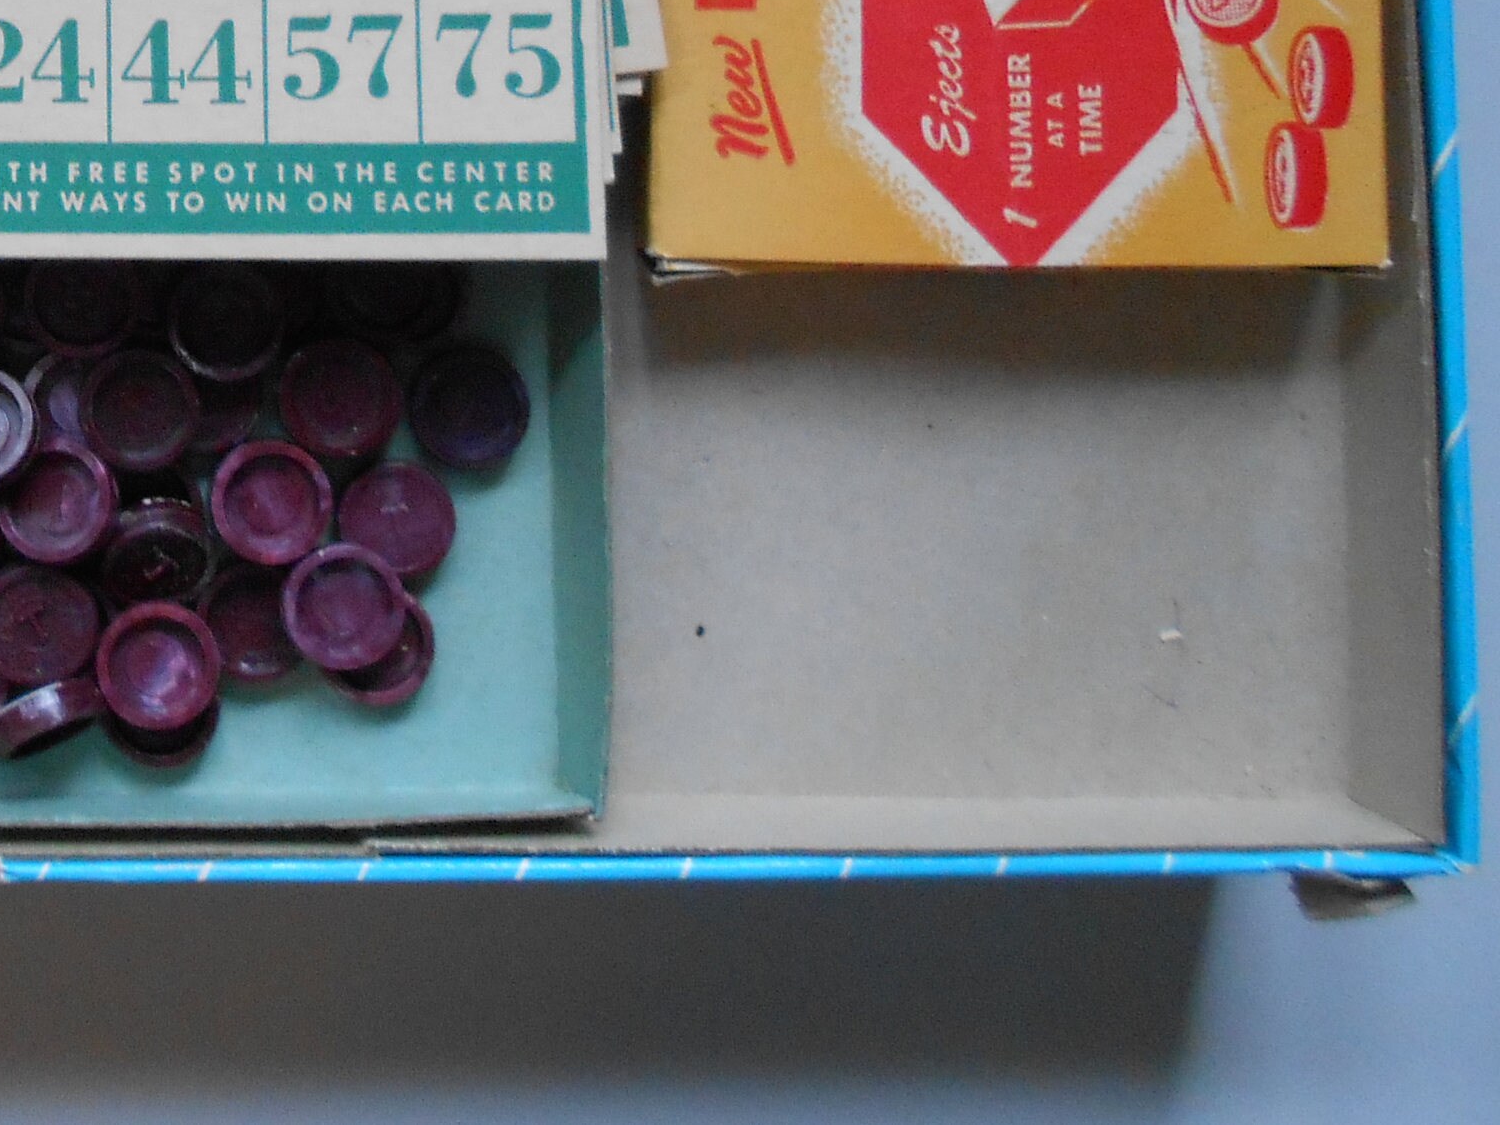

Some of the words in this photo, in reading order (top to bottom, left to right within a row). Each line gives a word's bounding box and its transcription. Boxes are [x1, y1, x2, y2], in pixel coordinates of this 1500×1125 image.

[122, 20, 251, 104] 44
[284, 15, 402, 100] 57
[437, 14, 561, 98] 75
[709, 34, 770, 159] New
[921, 24, 977, 156] Ejects
[1046, 91, 1065, 110] A
[1007, 51, 1032, 192] NUMBER
[1047, 118, 1063, 147] AT
[1077, 81, 1102, 156] TIME
[68, 161, 149, 184] FREE
[168, 161, 258, 185] SPOT
[277, 162, 315, 184] IN
[334, 161, 397, 184] THE
[416, 160, 553, 184] CENTER
[60, 190, 147, 214] WAYS
[166, 191, 205, 215] TO
[224, 191, 287, 213] WIN
[307, 191, 353, 214] ON
[373, 190, 454, 214] EACH
[474, 190, 556, 213] CARD
[1002, 207, 1038, 229] 1
